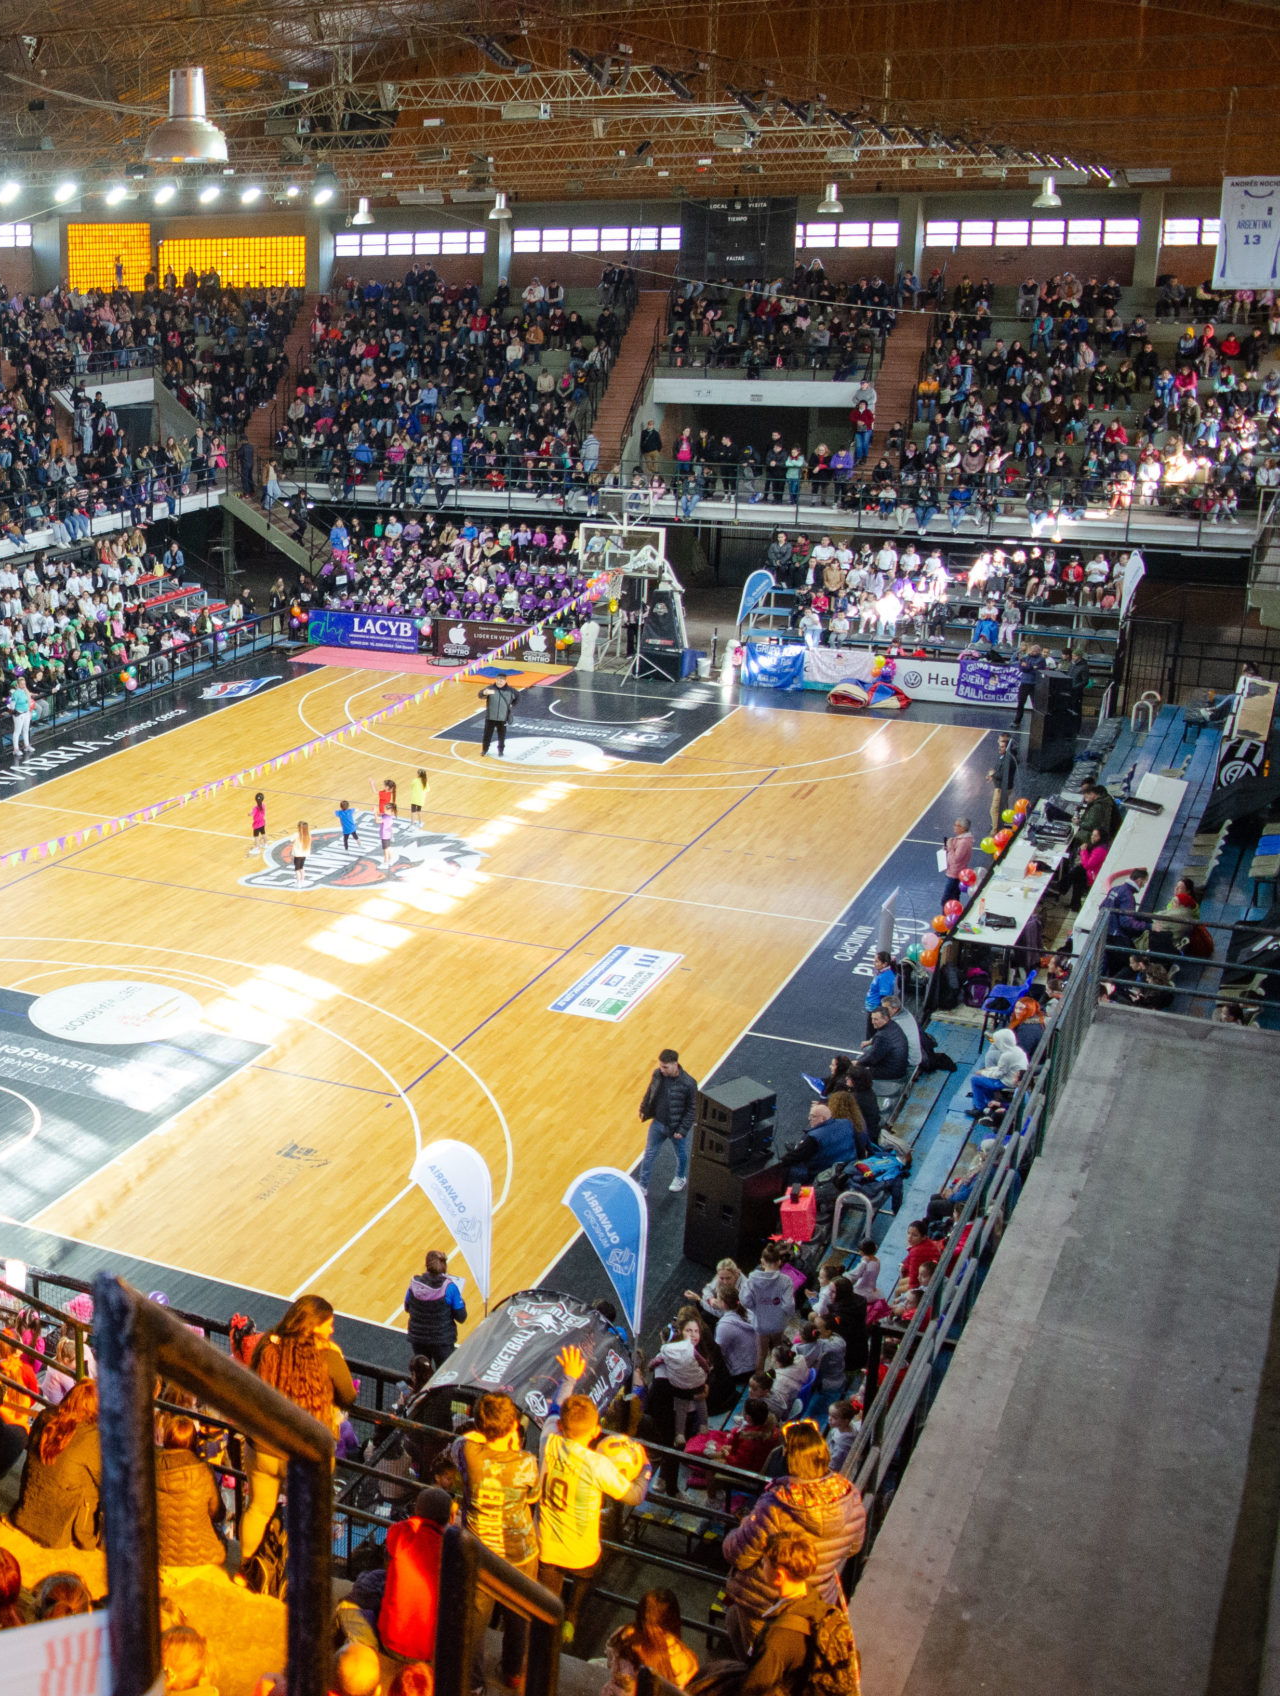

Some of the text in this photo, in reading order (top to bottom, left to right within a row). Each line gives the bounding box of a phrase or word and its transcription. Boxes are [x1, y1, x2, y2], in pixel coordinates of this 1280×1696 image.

[1244, 234, 1261, 245] 13
[353, 618, 412, 637] LACYB
[443, 647, 470, 656] CENTRO
[523, 655, 550, 663] CENTRO
[105, 718, 157, 742] Estamos
[481, 1328, 537, 1384] BASKETBALL
